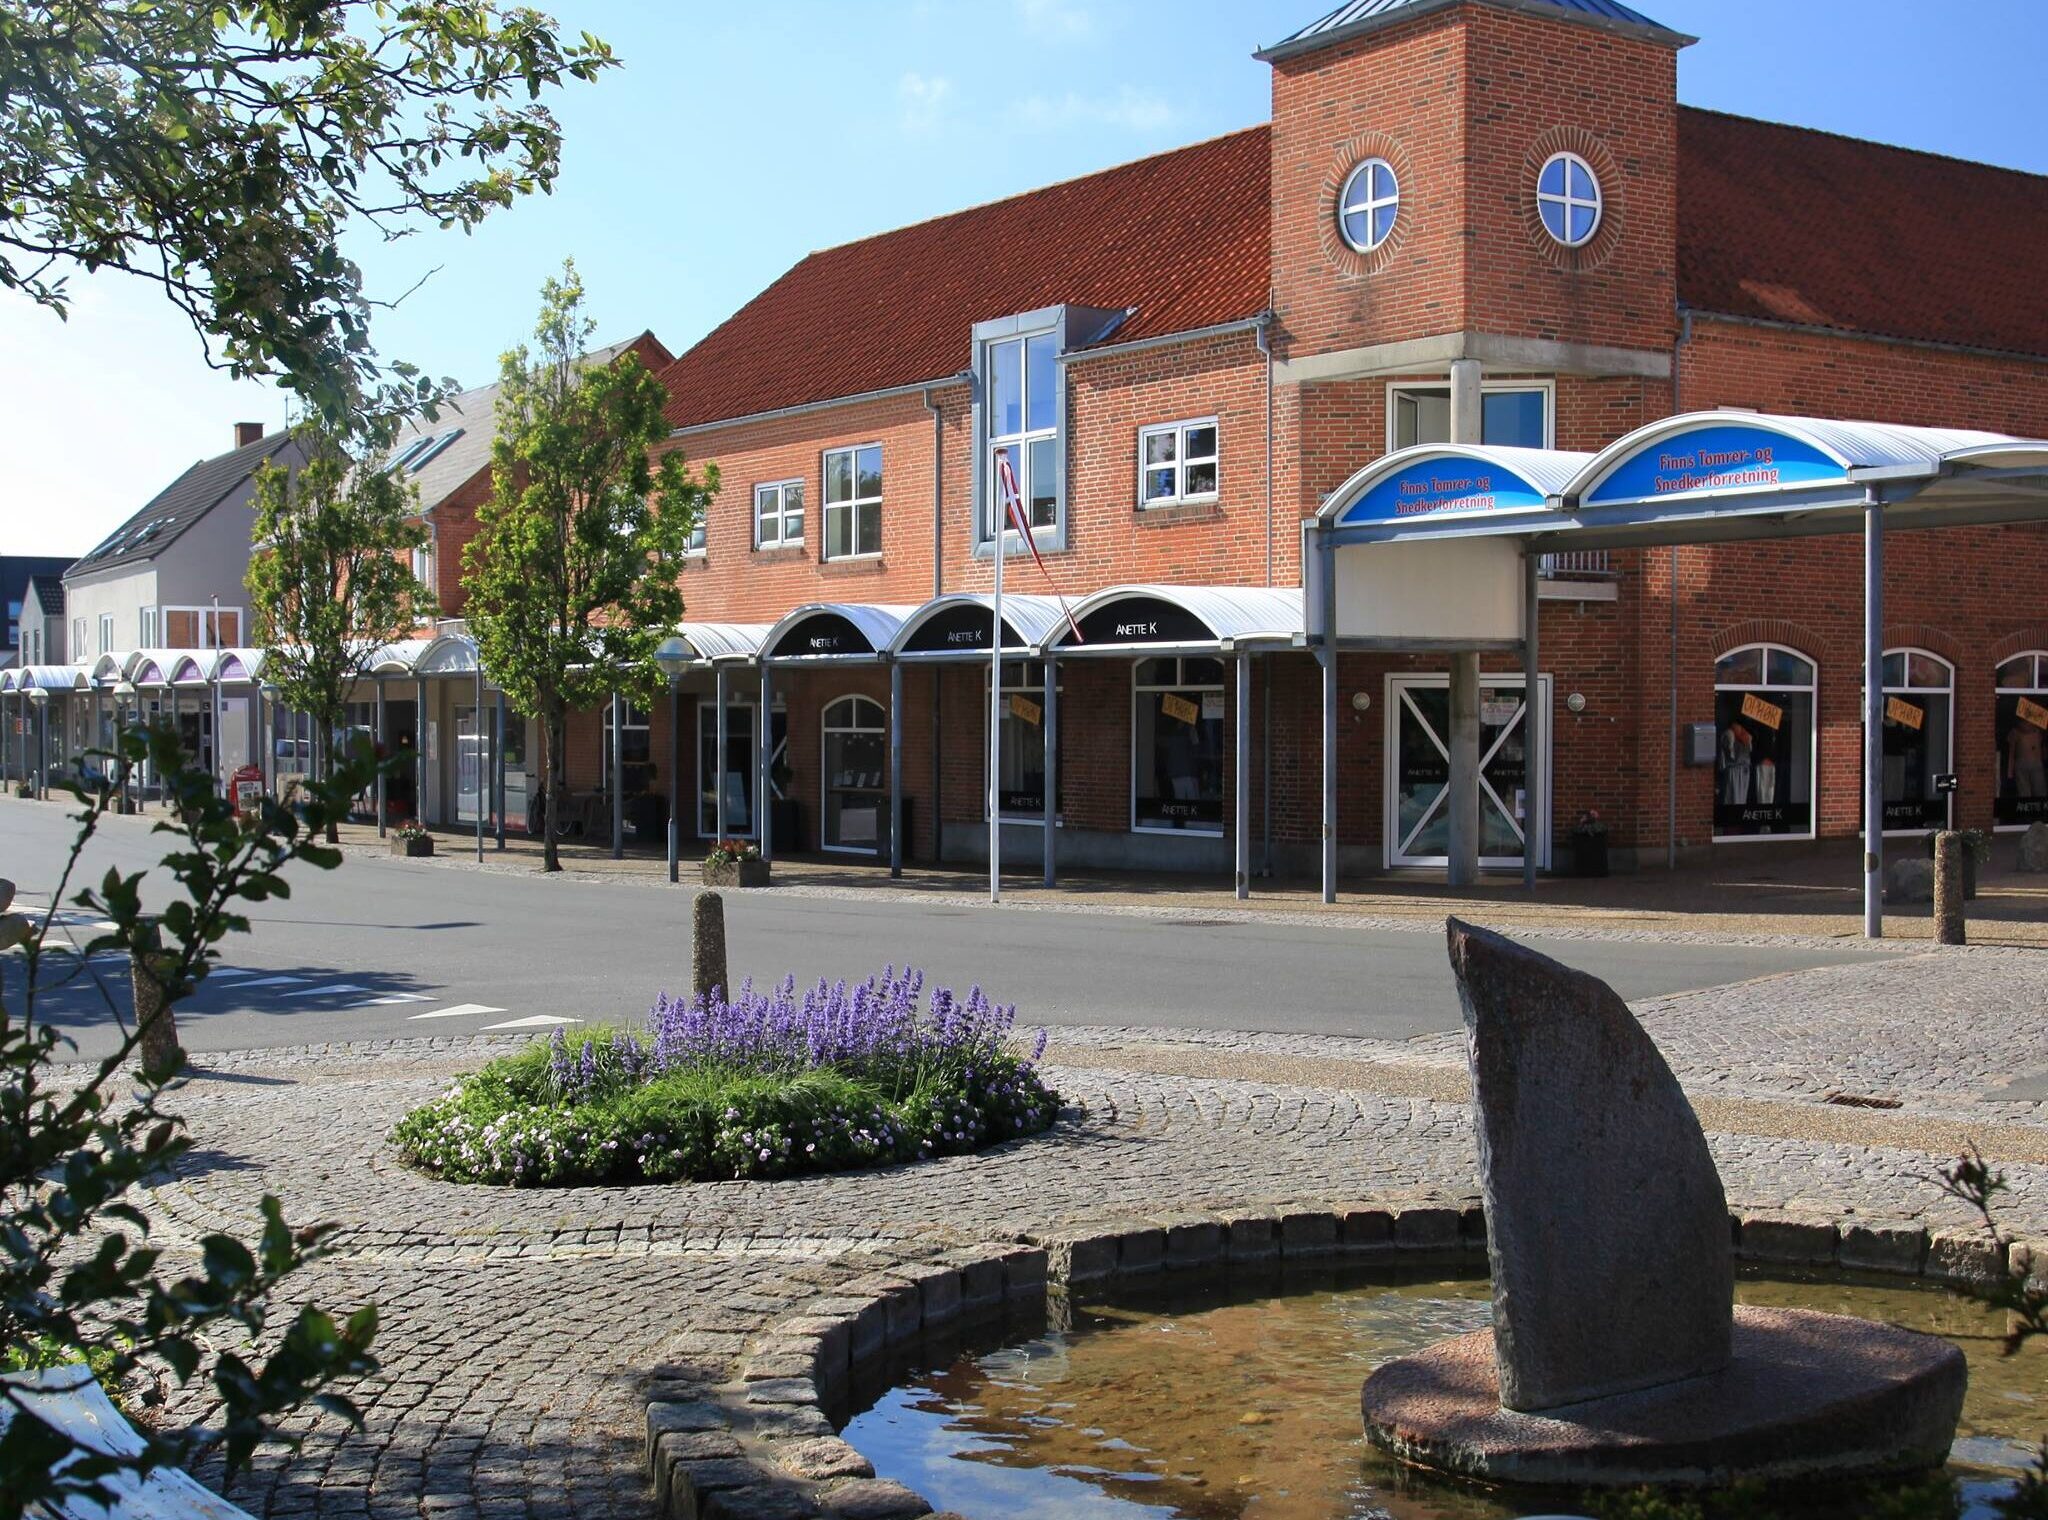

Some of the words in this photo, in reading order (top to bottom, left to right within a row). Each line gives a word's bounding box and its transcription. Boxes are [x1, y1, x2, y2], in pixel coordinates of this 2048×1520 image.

[1755, 447, 1773, 465] og
[1476, 476, 1490, 492] og
[1655, 467, 1778, 492] Snedkerforretning
[948, 631, 974, 642] ANETTE
[975, 630, 982, 641] K
[1115, 624, 1147, 636] ANETTE
[1149, 622, 1157, 635] K
[1742, 809, 1773, 821] ANETTE
[1775, 808, 1783, 820] K
[1886, 806, 1913, 817] ANETTE
[1915, 804, 1922, 816] K
